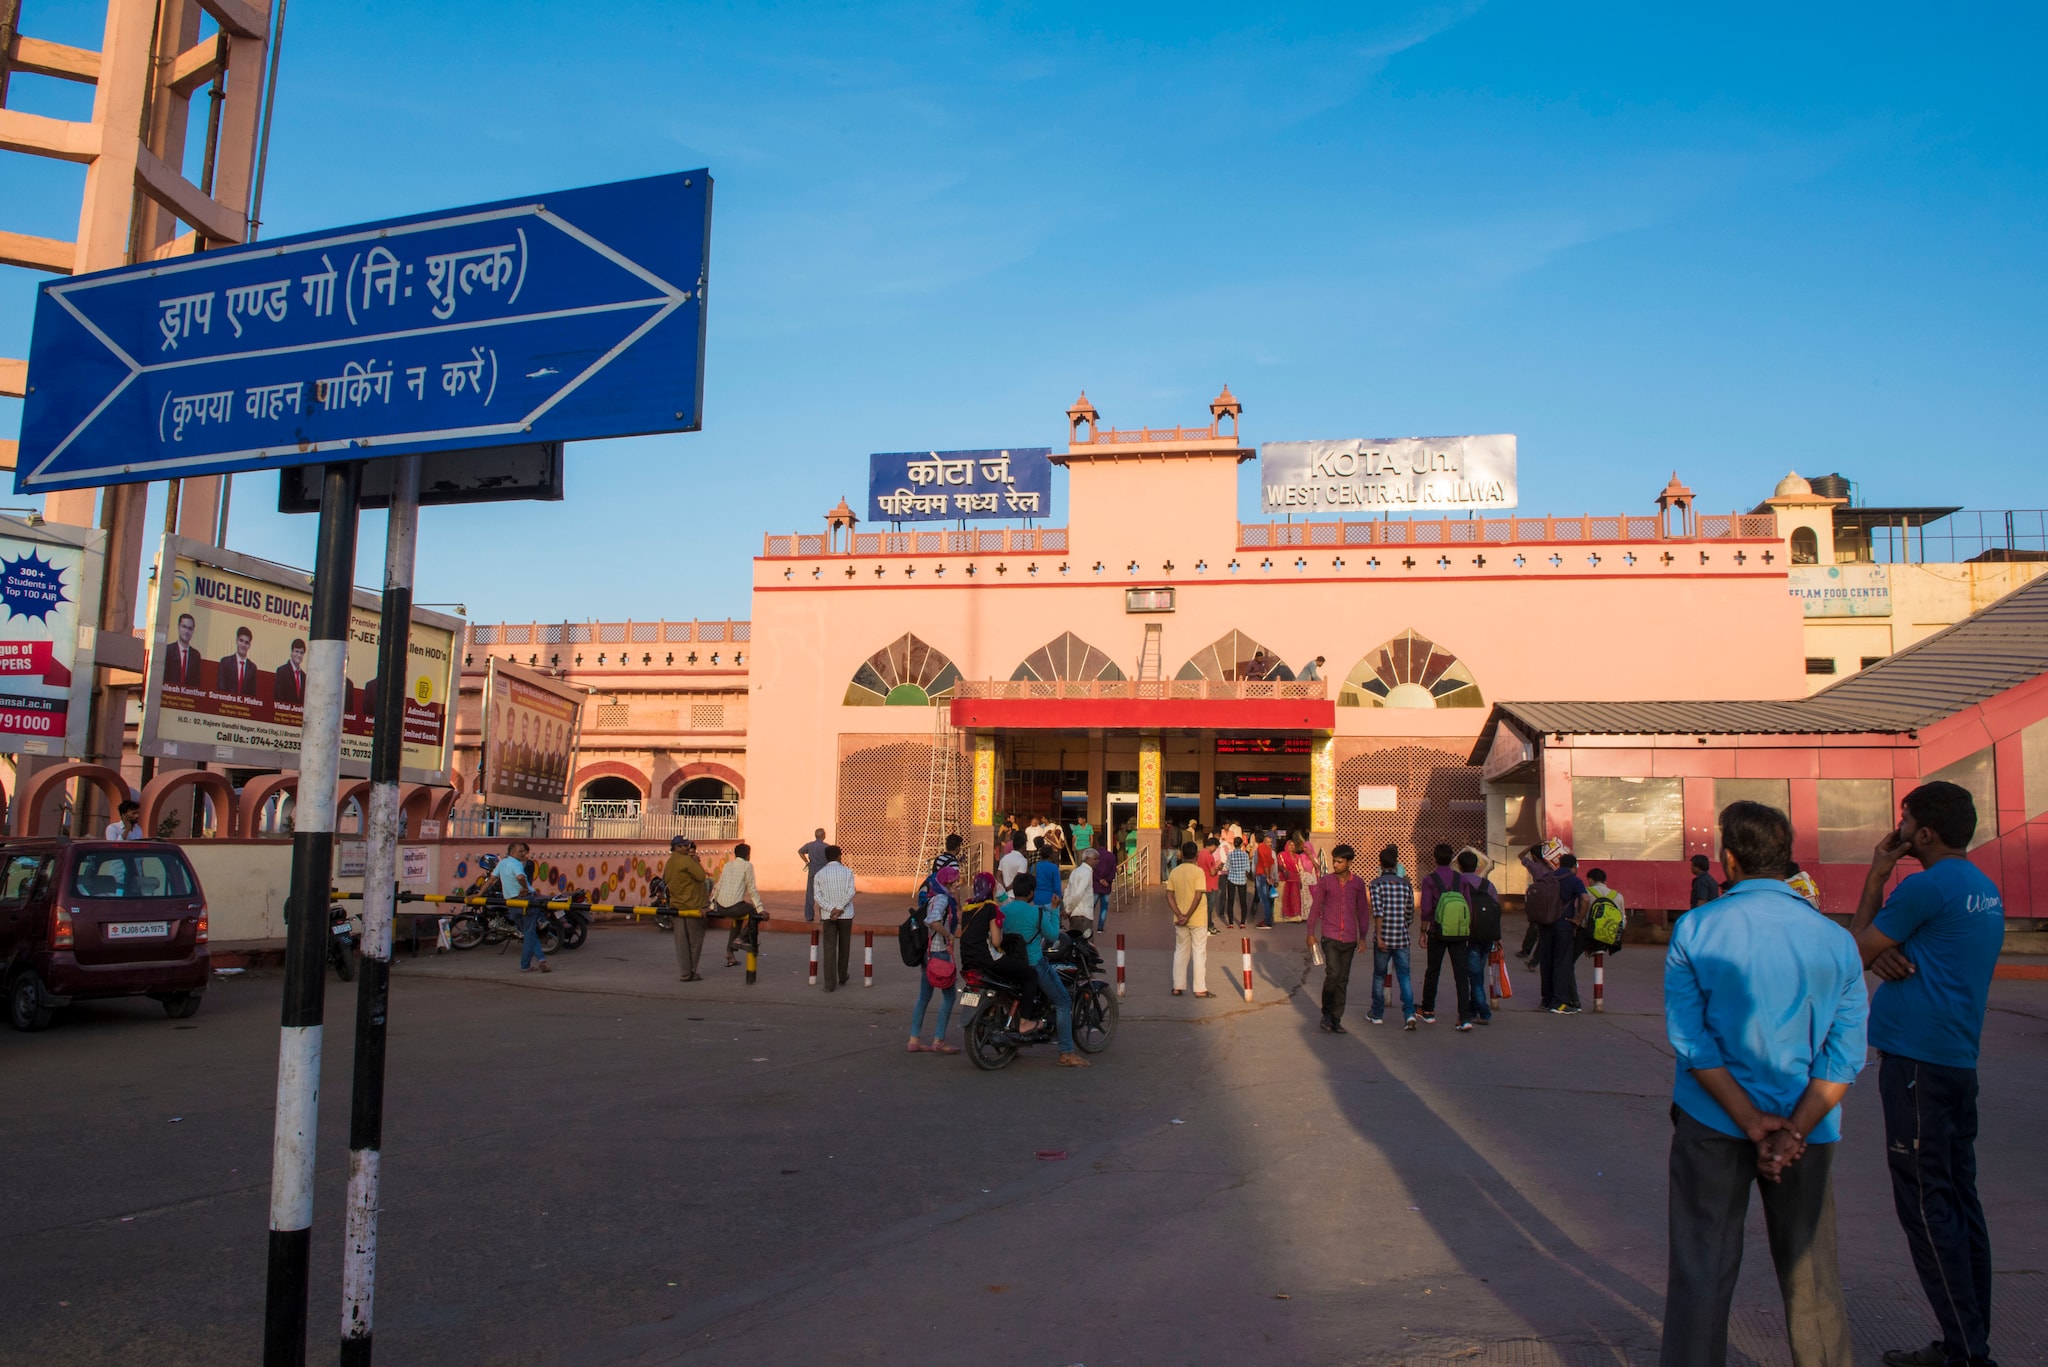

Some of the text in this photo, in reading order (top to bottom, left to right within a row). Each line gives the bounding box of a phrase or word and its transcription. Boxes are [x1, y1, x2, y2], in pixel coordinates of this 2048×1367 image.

[159, 292, 215, 351] ड्राप
[226, 279, 291, 338] एण्ड
[301, 253, 338, 317] गो
[425, 228, 528, 320] शुल्क)
[159, 390, 235, 442] (कृपया
[246, 381, 304, 421] वाहन
[406, 366, 427, 401] न
[441, 346, 497, 407] करें)
[907, 450, 1016, 487] कोटा जं.
[1310, 448, 1458, 477] KOTA Jn.
[877, 485, 1040, 516] पश्चिम मध्य रेल
[1266, 484, 1321, 507] WEST
[1325, 482, 1418, 505] CENTRAL
[7, 576, 57, 591] Students in
[5, 586, 57, 602] Top 100 AIR
[195, 576, 313, 622] NUCLEUS EDUCA
[1824, 588, 1848, 598] FOOD
[1850, 587, 1888, 597] CENTER
[262, 614, 288, 628] Centre
[289, 621, 298, 630] of
[351, 616, 377, 630] Premier
[21, 643, 33, 655] of
[0, 658, 32, 670] PERS
[216, 731, 232, 743] Call
